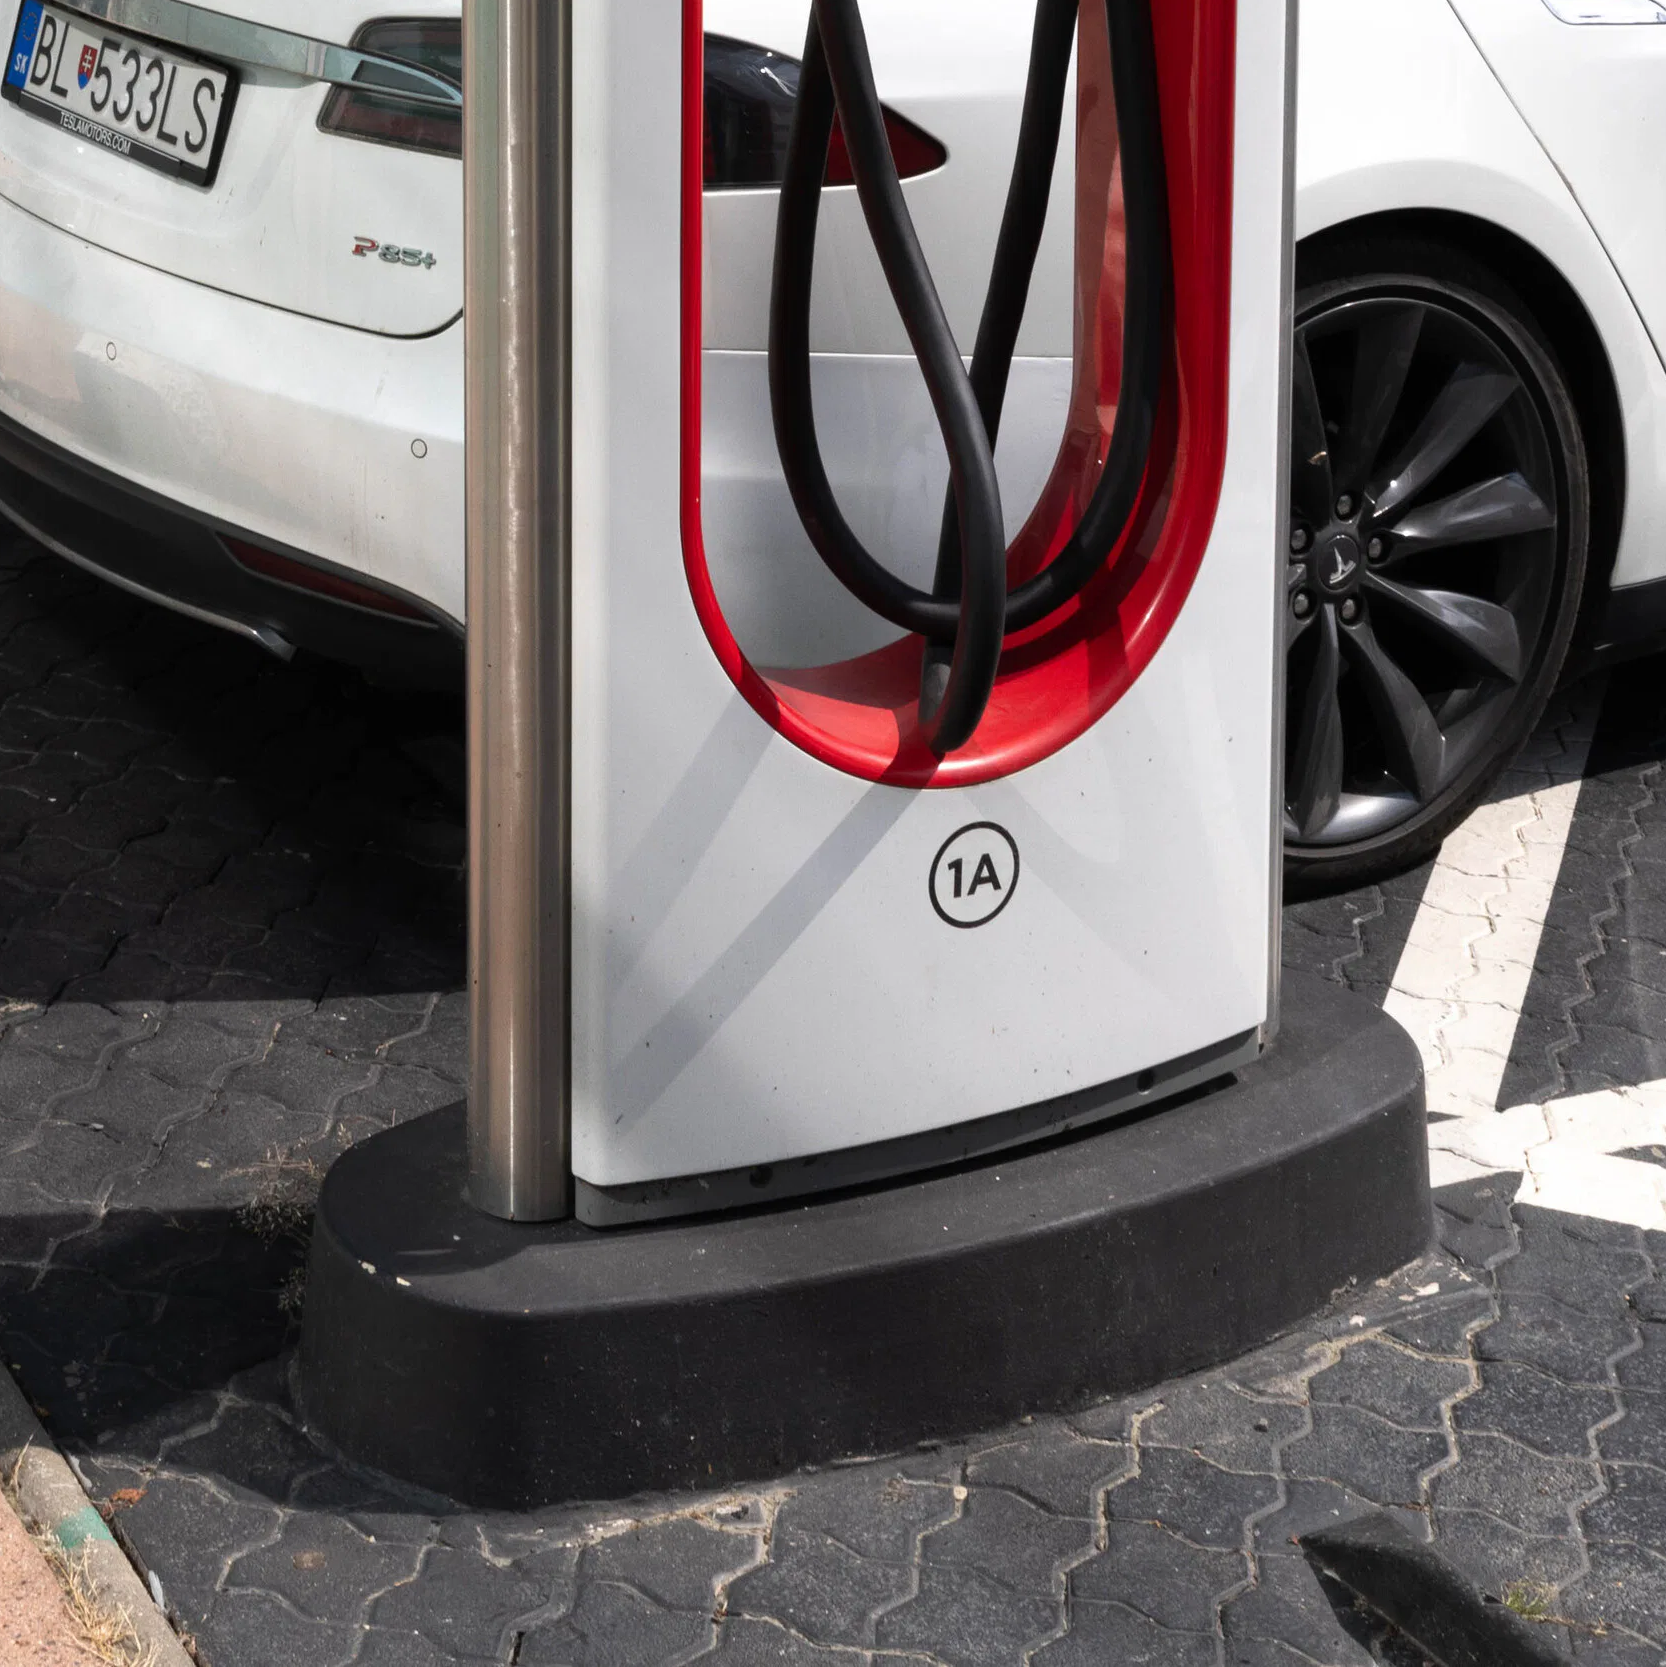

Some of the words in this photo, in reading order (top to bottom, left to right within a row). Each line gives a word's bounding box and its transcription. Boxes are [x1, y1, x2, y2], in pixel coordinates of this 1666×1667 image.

[14, 52, 27, 74] SK
[30, 15, 70, 98] BL
[91, 37, 216, 153] 533LS
[59, 112, 132, 155] TESLAMOTORS.COM
[947, 852, 1002, 898] 1A
